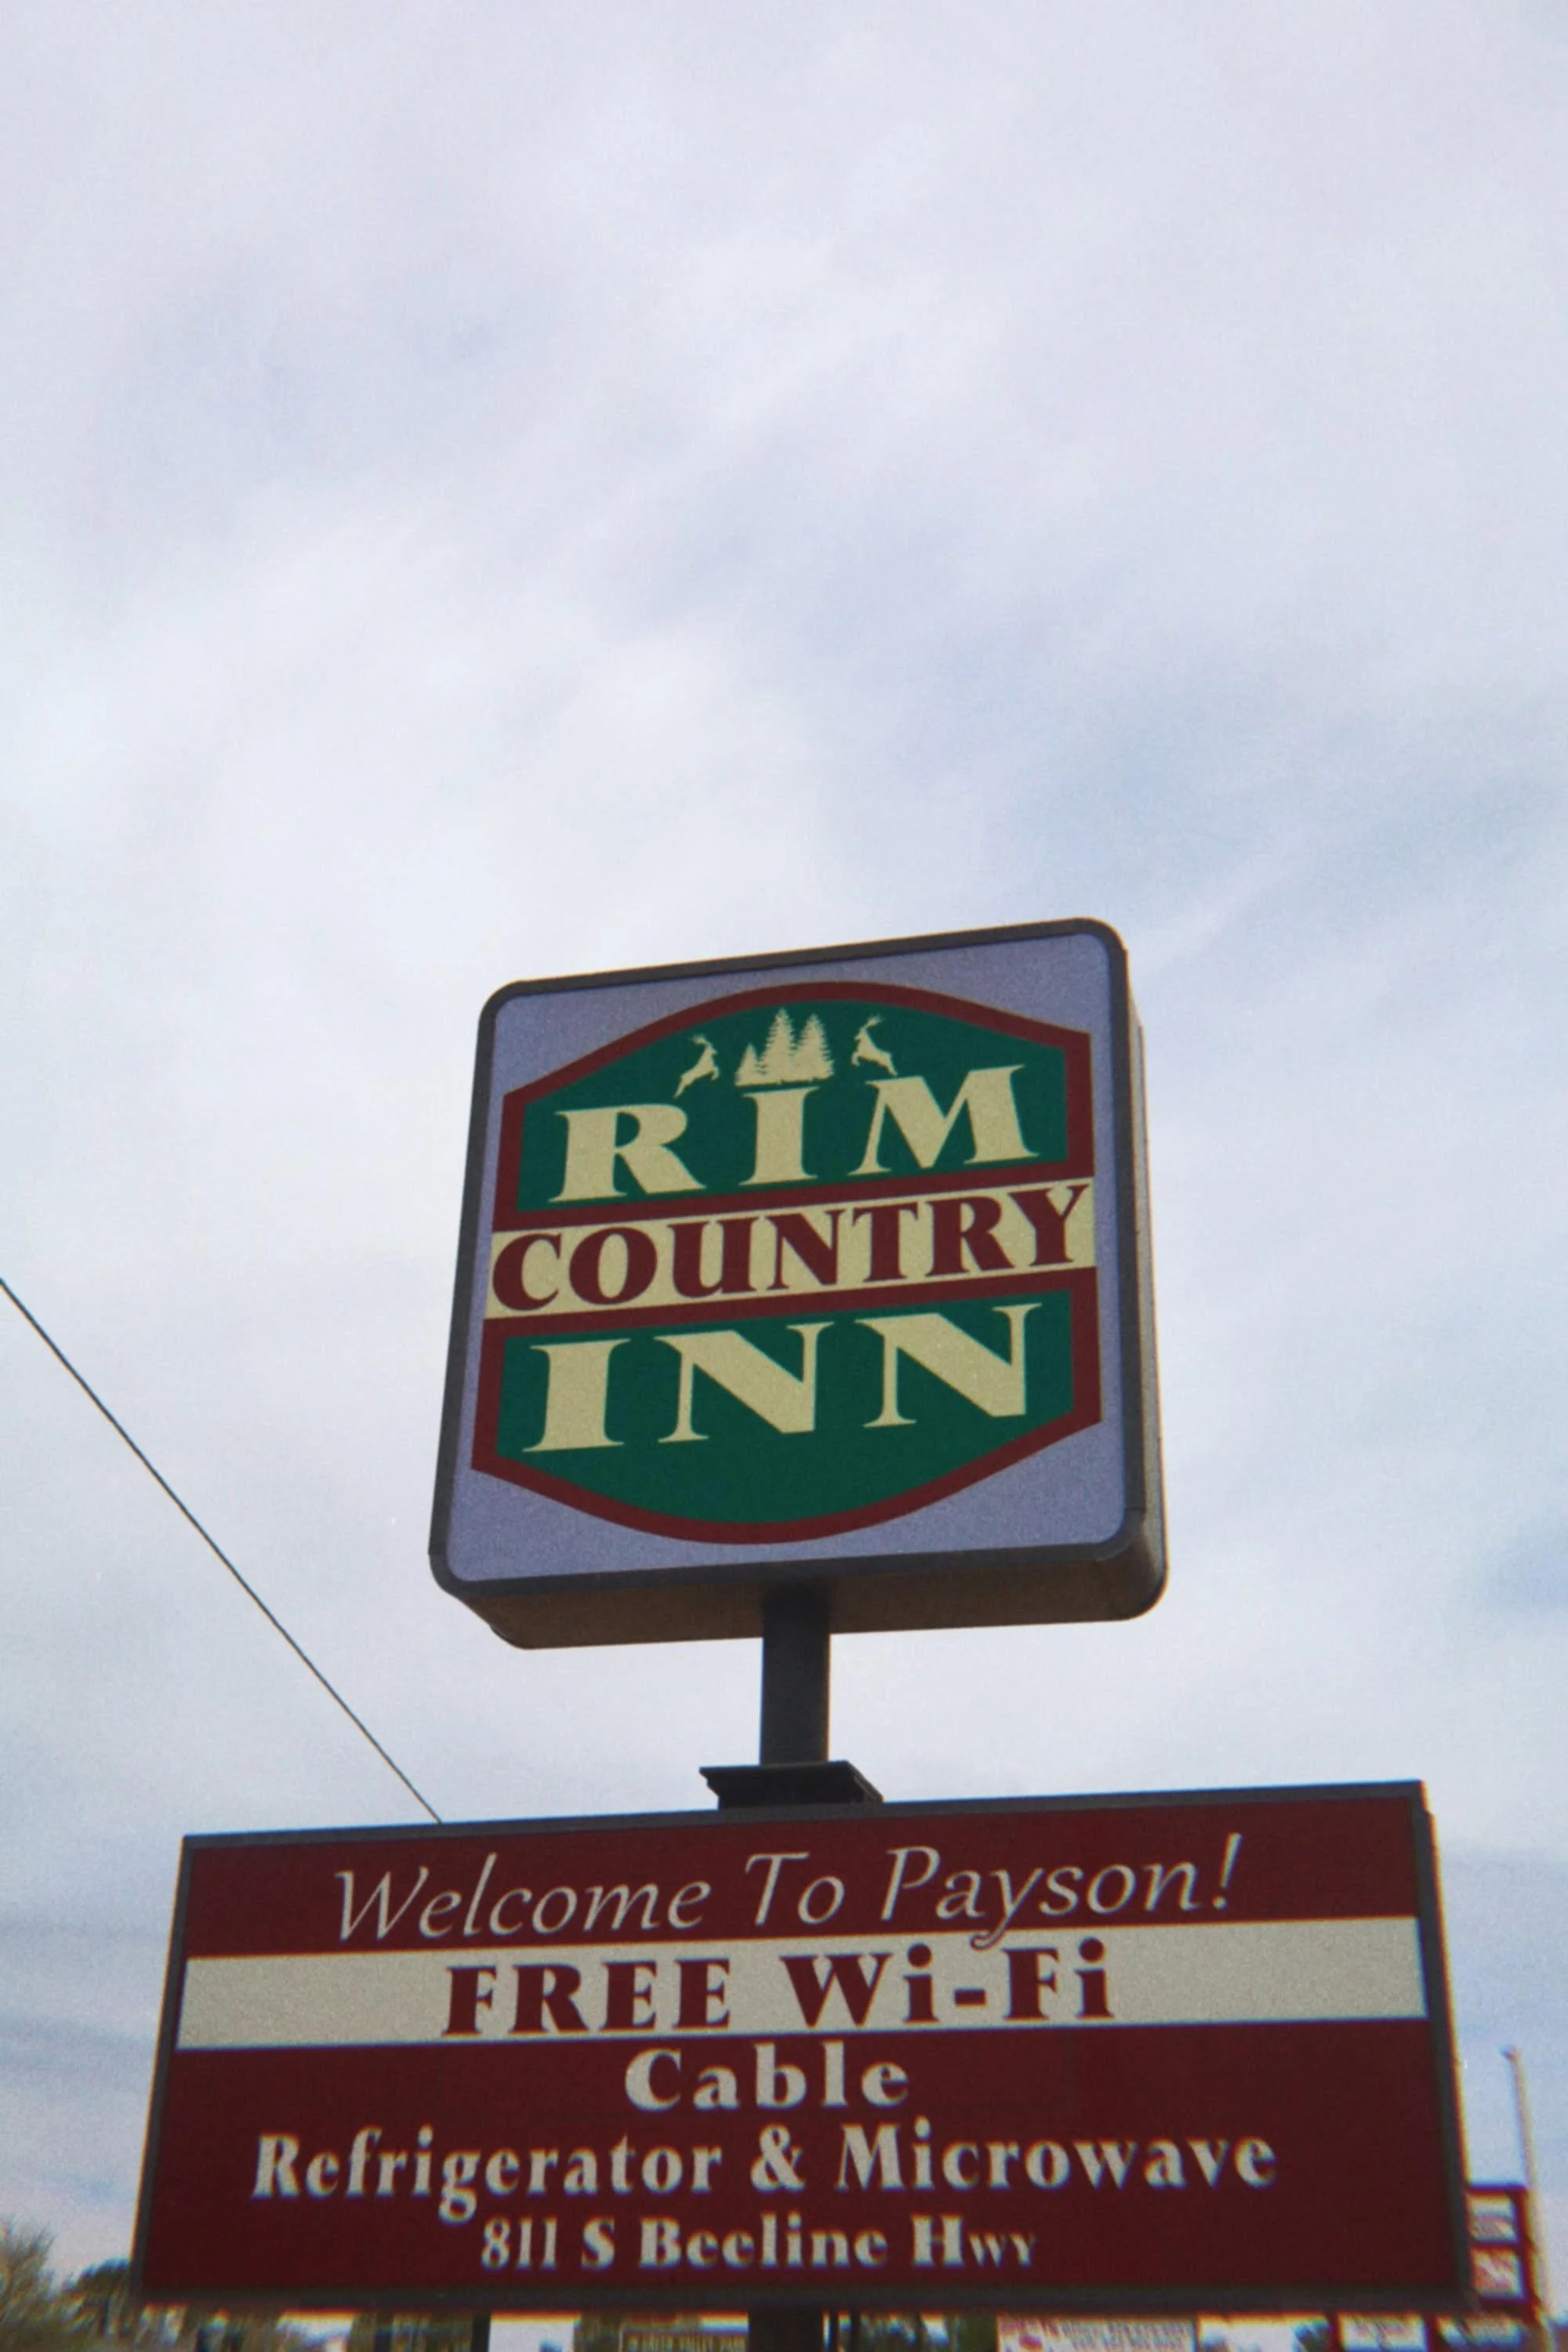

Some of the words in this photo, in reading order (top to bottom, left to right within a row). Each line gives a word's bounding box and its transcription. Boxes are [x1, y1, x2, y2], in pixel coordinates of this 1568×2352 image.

[548, 1064, 1040, 1204] RIM
[491, 1183, 1091, 1311] COUNTRY
[522, 1303, 1043, 1453] INN
[335, 1853, 712, 1942] Welcome
[745, 1852, 844, 1927] To
[880, 1832, 1243, 1949] Payson!
[441, 1958, 731, 2038] FREE
[779, 1937, 1115, 2027] Wi-Fi
[625, 2040, 909, 2112] Cable
[254, 2124, 723, 2225] Refrigerator
[750, 2123, 807, 2193] &
[834, 2115, 1278, 2191] Microwave
[480, 2216, 559, 2270] 811
[581, 2216, 616, 2270] S
[637, 2210, 889, 2270] Beeline
